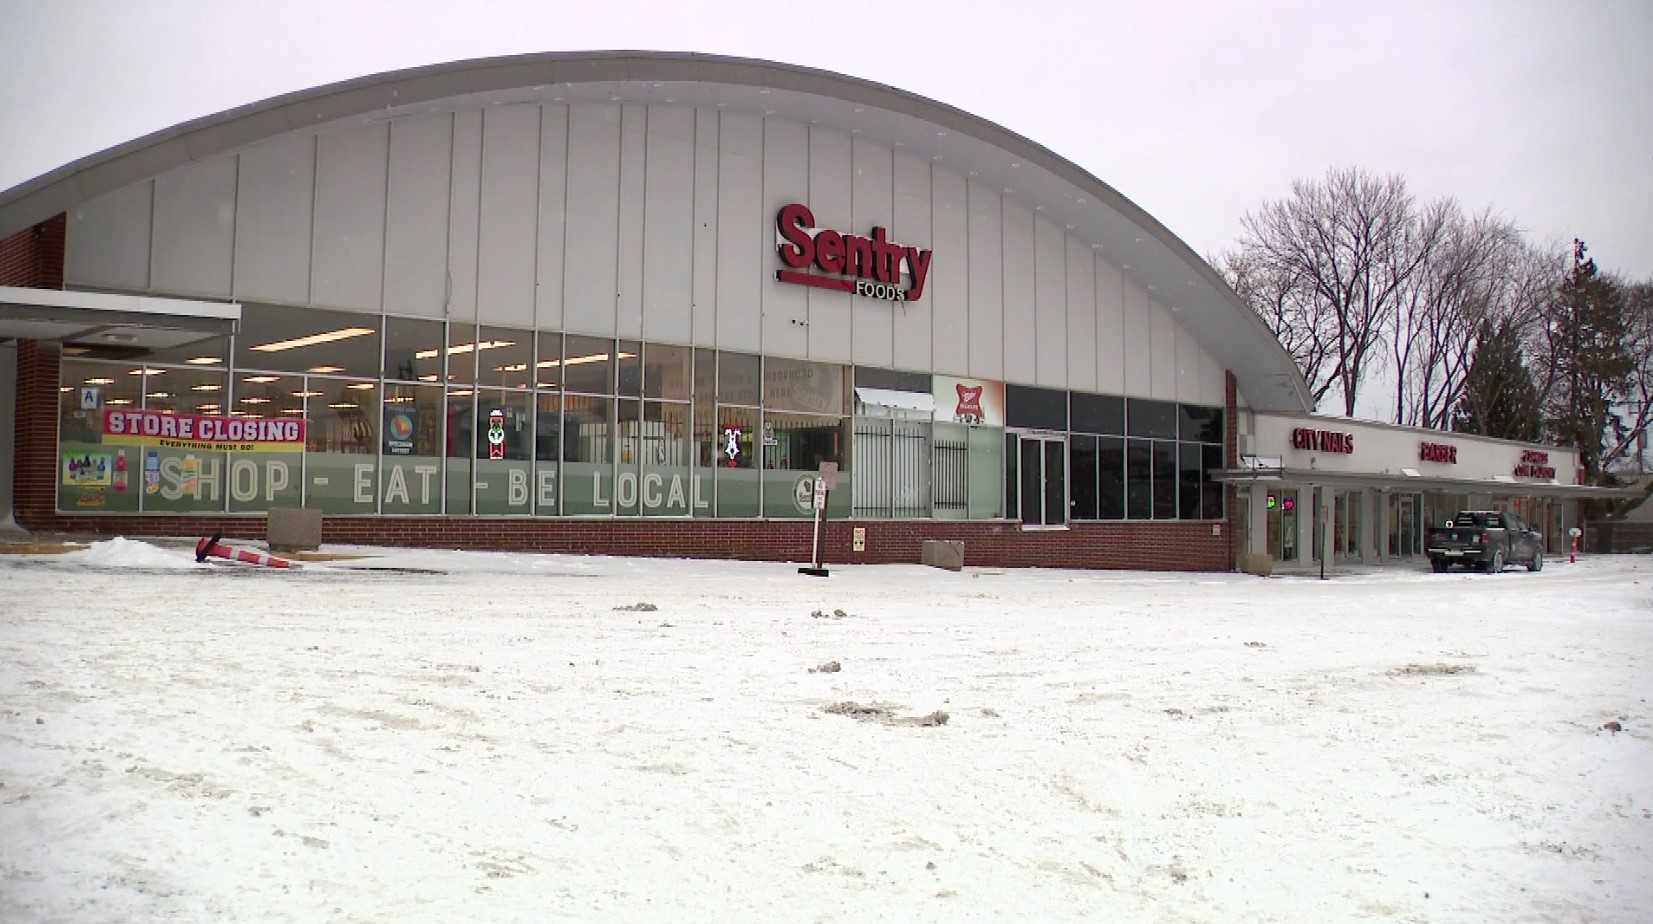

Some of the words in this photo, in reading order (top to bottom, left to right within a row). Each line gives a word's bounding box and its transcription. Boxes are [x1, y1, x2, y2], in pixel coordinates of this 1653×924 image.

[776, 203, 933, 302] Sentry
[855, 280, 906, 301] FOODS
[108, 411, 193, 439] STORE
[198, 419, 300, 442] CLOSING
[1293, 427, 1319, 450] CITY
[1320, 431, 1354, 454] NAILS
[159, 440, 213, 450] EVERYTHING
[215, 443, 237, 451] MUST
[159, 457, 289, 502] SHOP
[353, 463, 438, 505] EAT
[508, 469, 556, 506] BE
[593, 471, 710, 509] LOCAL
